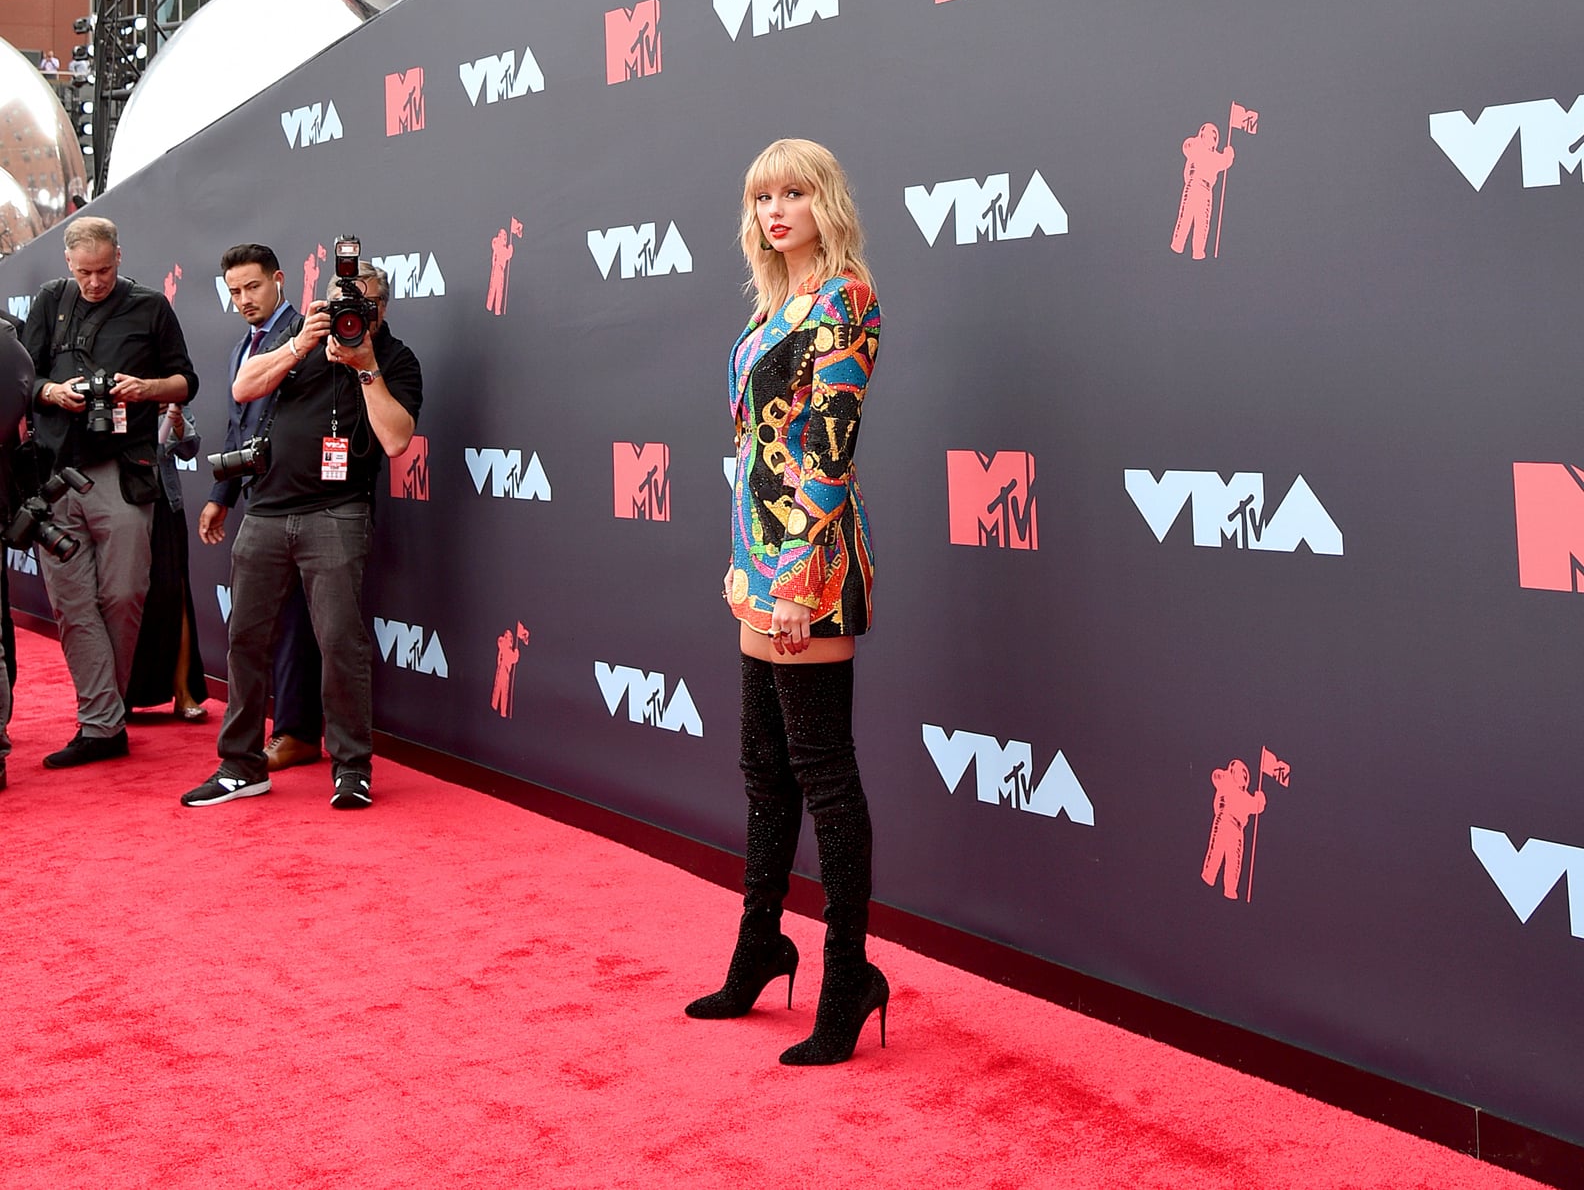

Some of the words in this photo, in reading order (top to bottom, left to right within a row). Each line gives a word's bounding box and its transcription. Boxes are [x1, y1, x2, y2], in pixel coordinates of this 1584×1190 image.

[459, 46, 544, 106] VMA
[605, 0, 661, 83] MTV
[281, 100, 343, 149] VMA
[385, 68, 424, 136] MTV
[1429, 95, 1584, 192] VM
[905, 170, 1068, 247] VMA
[588, 221, 692, 280] VMA
[466, 448, 551, 501] VMA
[613, 442, 670, 521] MTV
[947, 450, 1038, 550] MTV
[1125, 469, 1343, 555] VMA
[374, 617, 448, 678] VMA
[595, 661, 703, 737] VMA
[923, 724, 1094, 826] VMA
